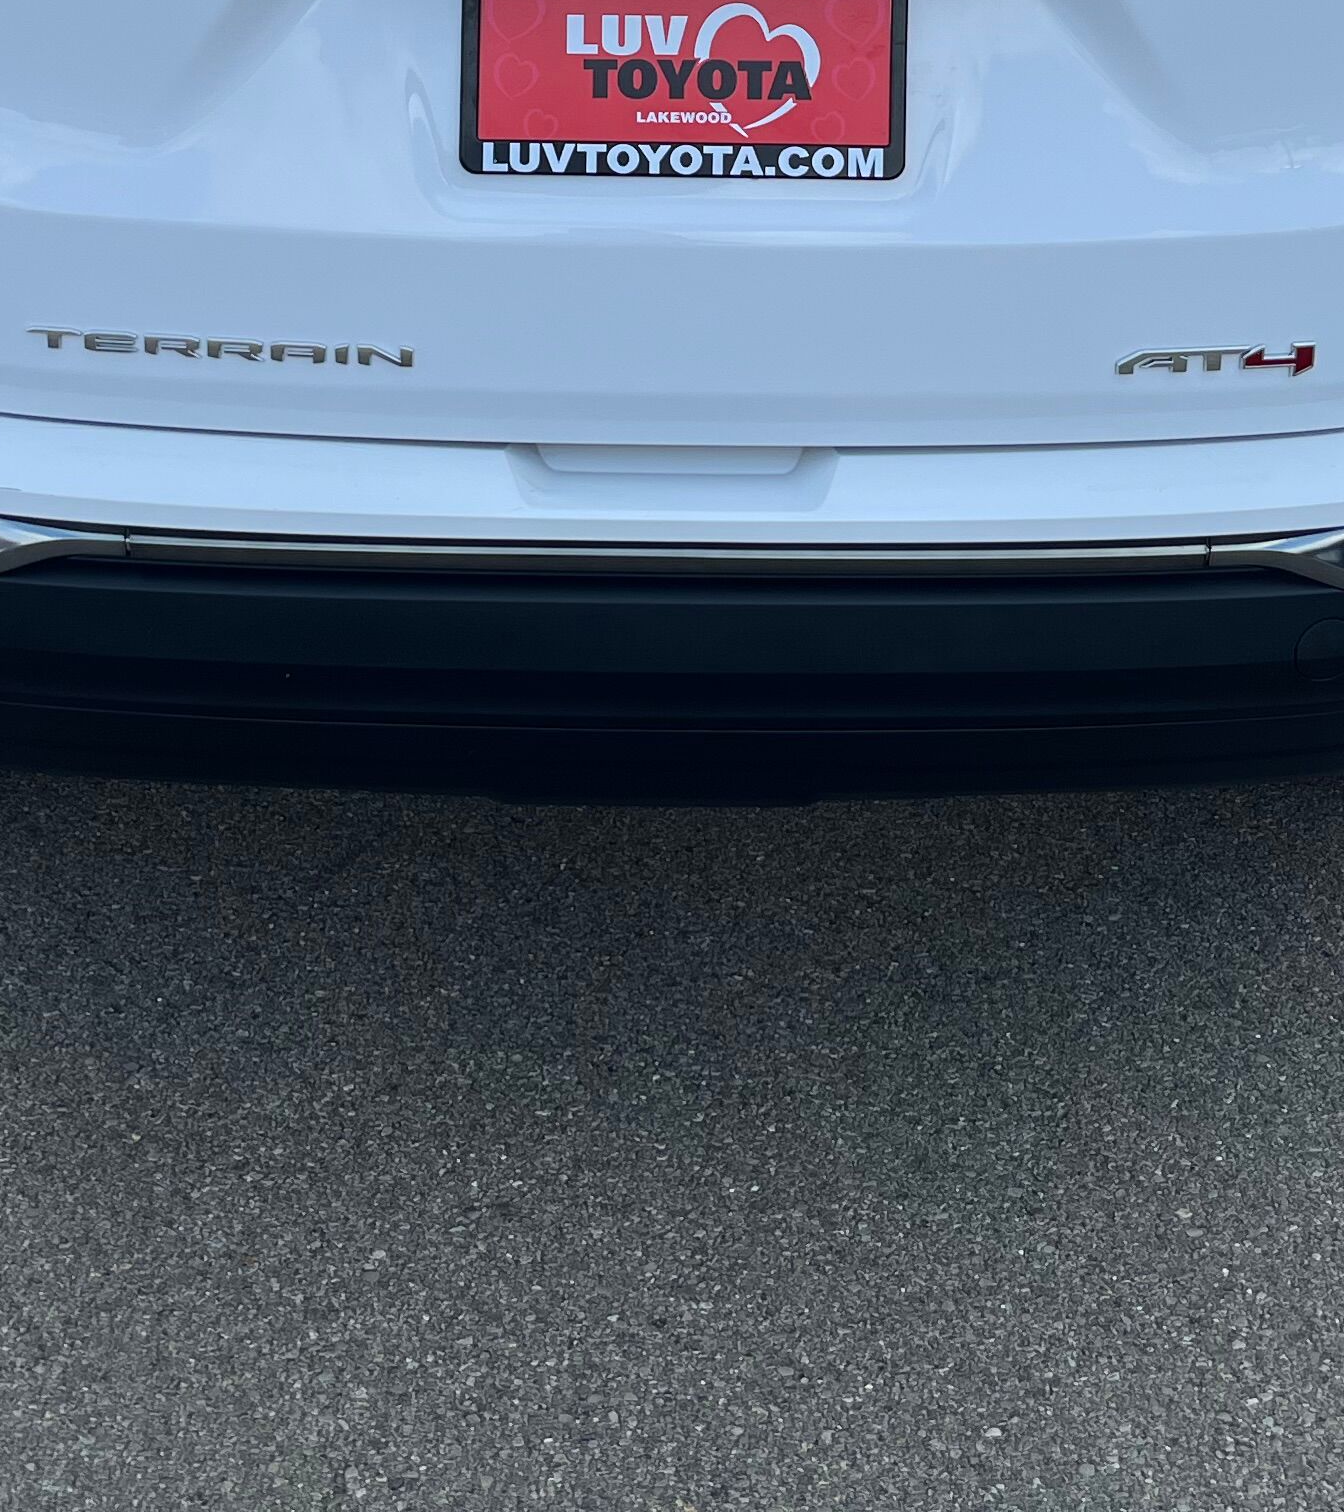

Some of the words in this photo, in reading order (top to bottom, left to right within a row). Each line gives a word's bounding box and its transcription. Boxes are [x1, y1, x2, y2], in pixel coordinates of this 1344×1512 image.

[566, 14, 688, 56] LUV
[583, 59, 812, 100] TOYOTA
[636, 111, 732, 124] LAKEWOOD
[481, 141, 885, 178] LUVTOYOTA.COM
[24, 324, 414, 368] TERRAIN
[1115, 340, 1317, 377] AT4
